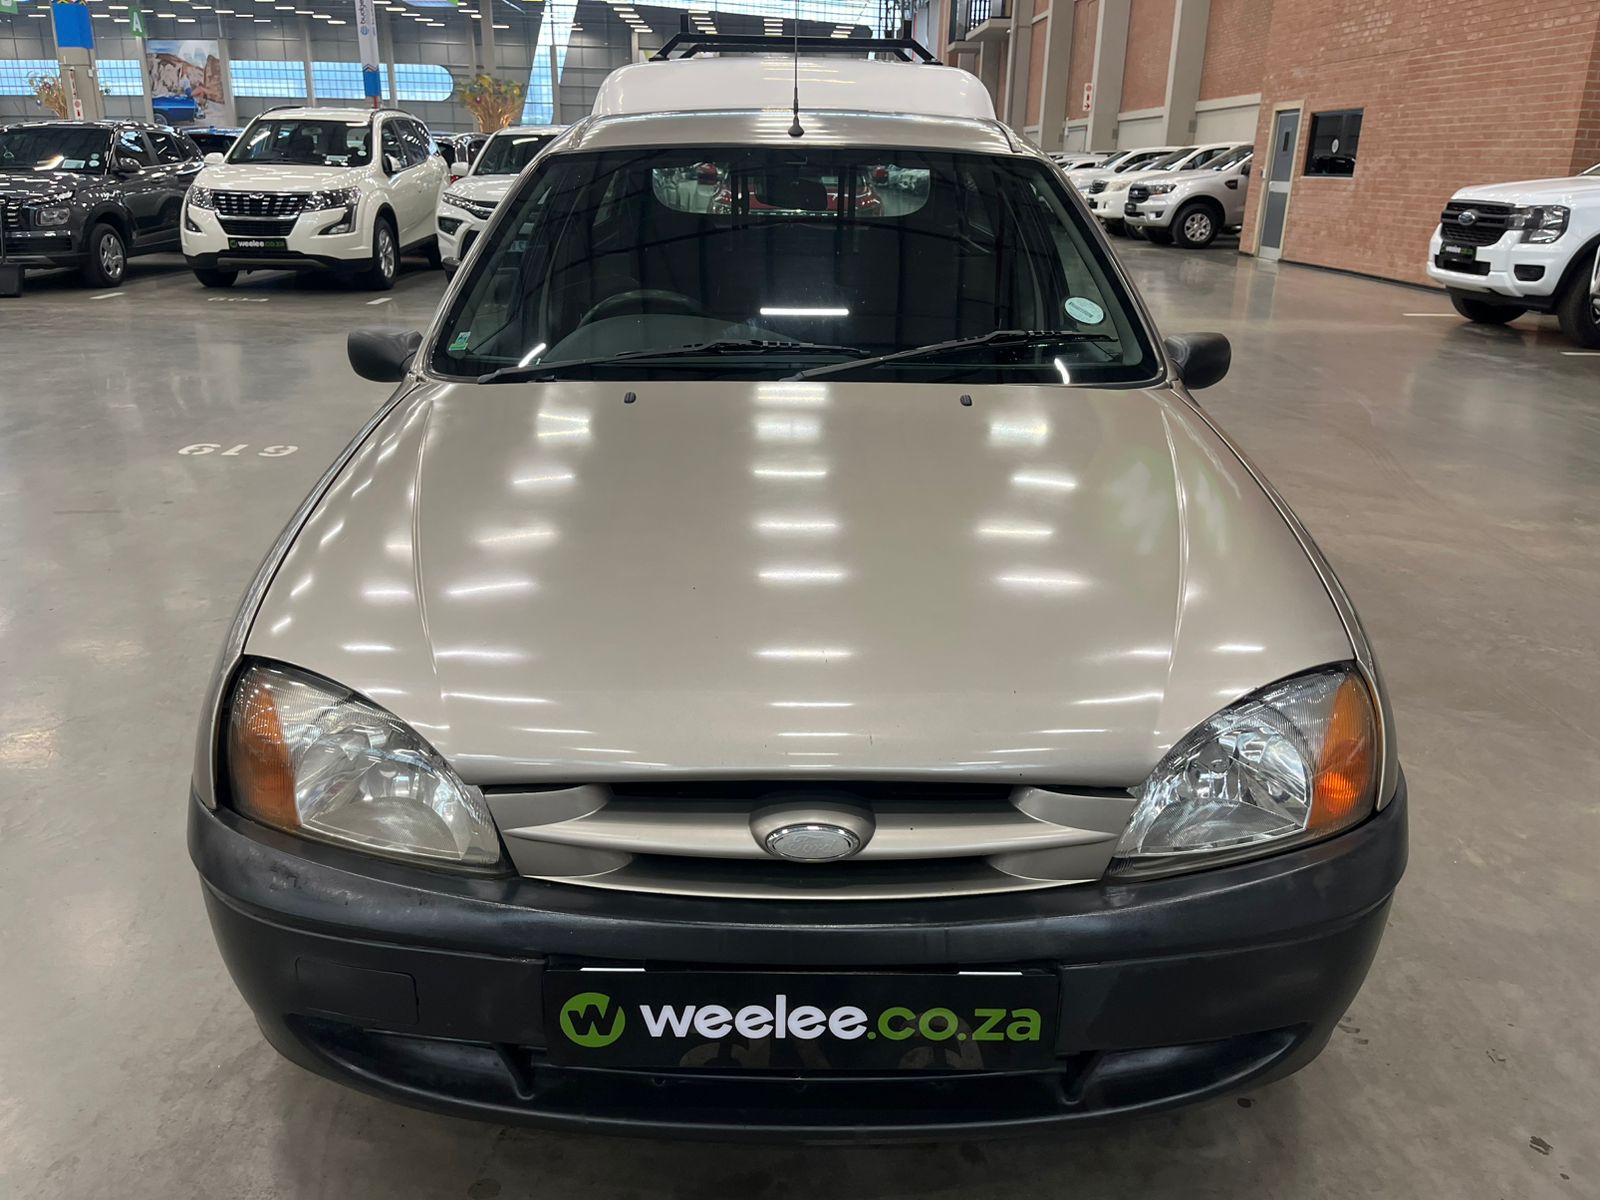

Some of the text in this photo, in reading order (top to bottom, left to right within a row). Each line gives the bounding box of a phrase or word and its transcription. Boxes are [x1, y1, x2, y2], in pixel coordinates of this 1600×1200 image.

[132, 11, 143, 33] A
[178, 443, 299, 457] 619
[639, 994, 1042, 1041] weelee.co.za
